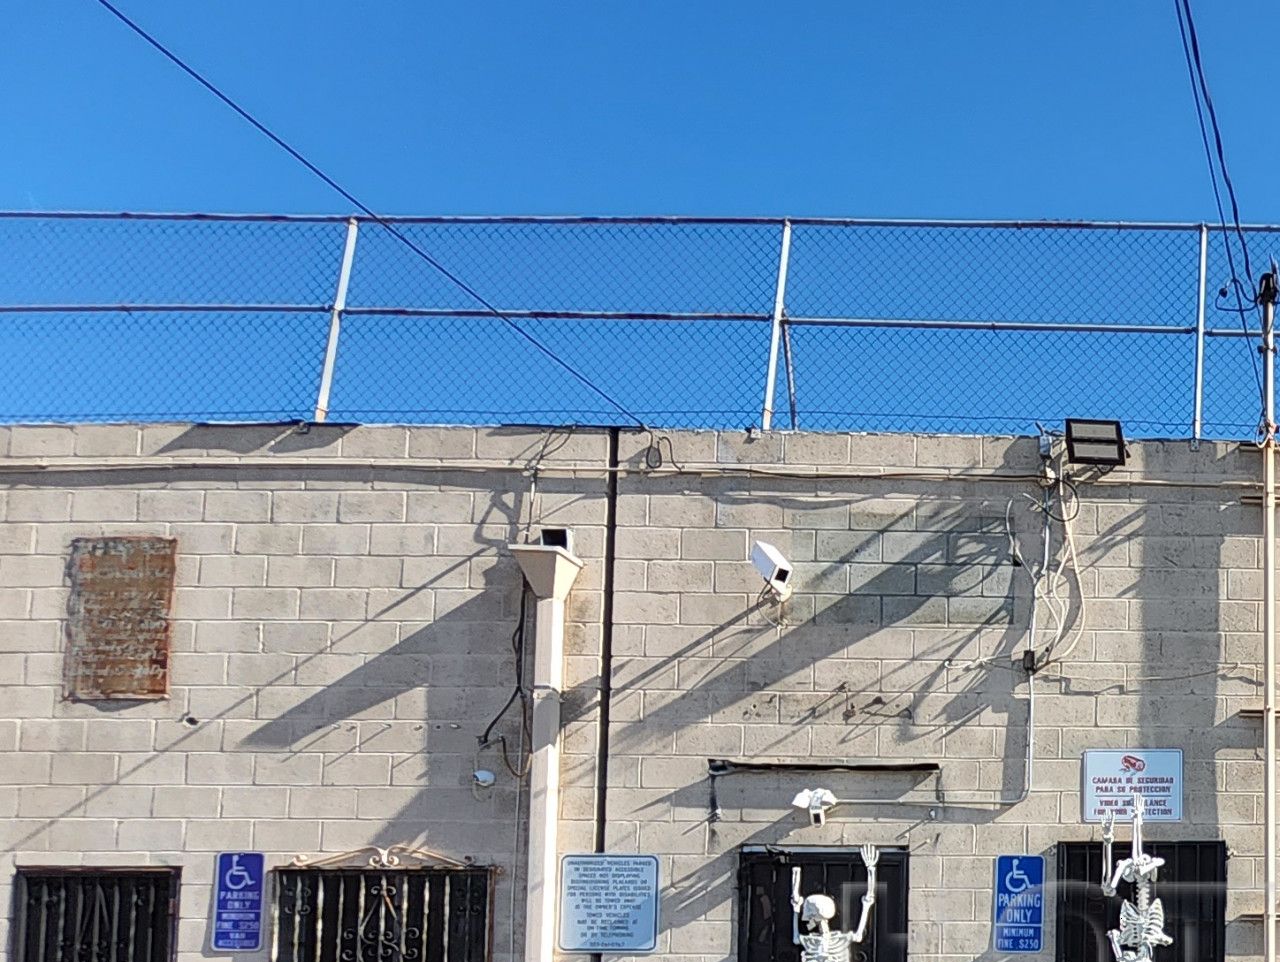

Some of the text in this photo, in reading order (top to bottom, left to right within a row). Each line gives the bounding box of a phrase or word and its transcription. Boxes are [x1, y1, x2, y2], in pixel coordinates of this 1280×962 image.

[220, 892, 259, 900] PARKING
[999, 893, 1041, 908] PARKING
[227, 901, 250, 909] ONLY
[1007, 909, 1032, 923] ONLY
[1003, 928, 1034, 937] MINIMUM
[998, 939, 1038, 950] FINE $250
